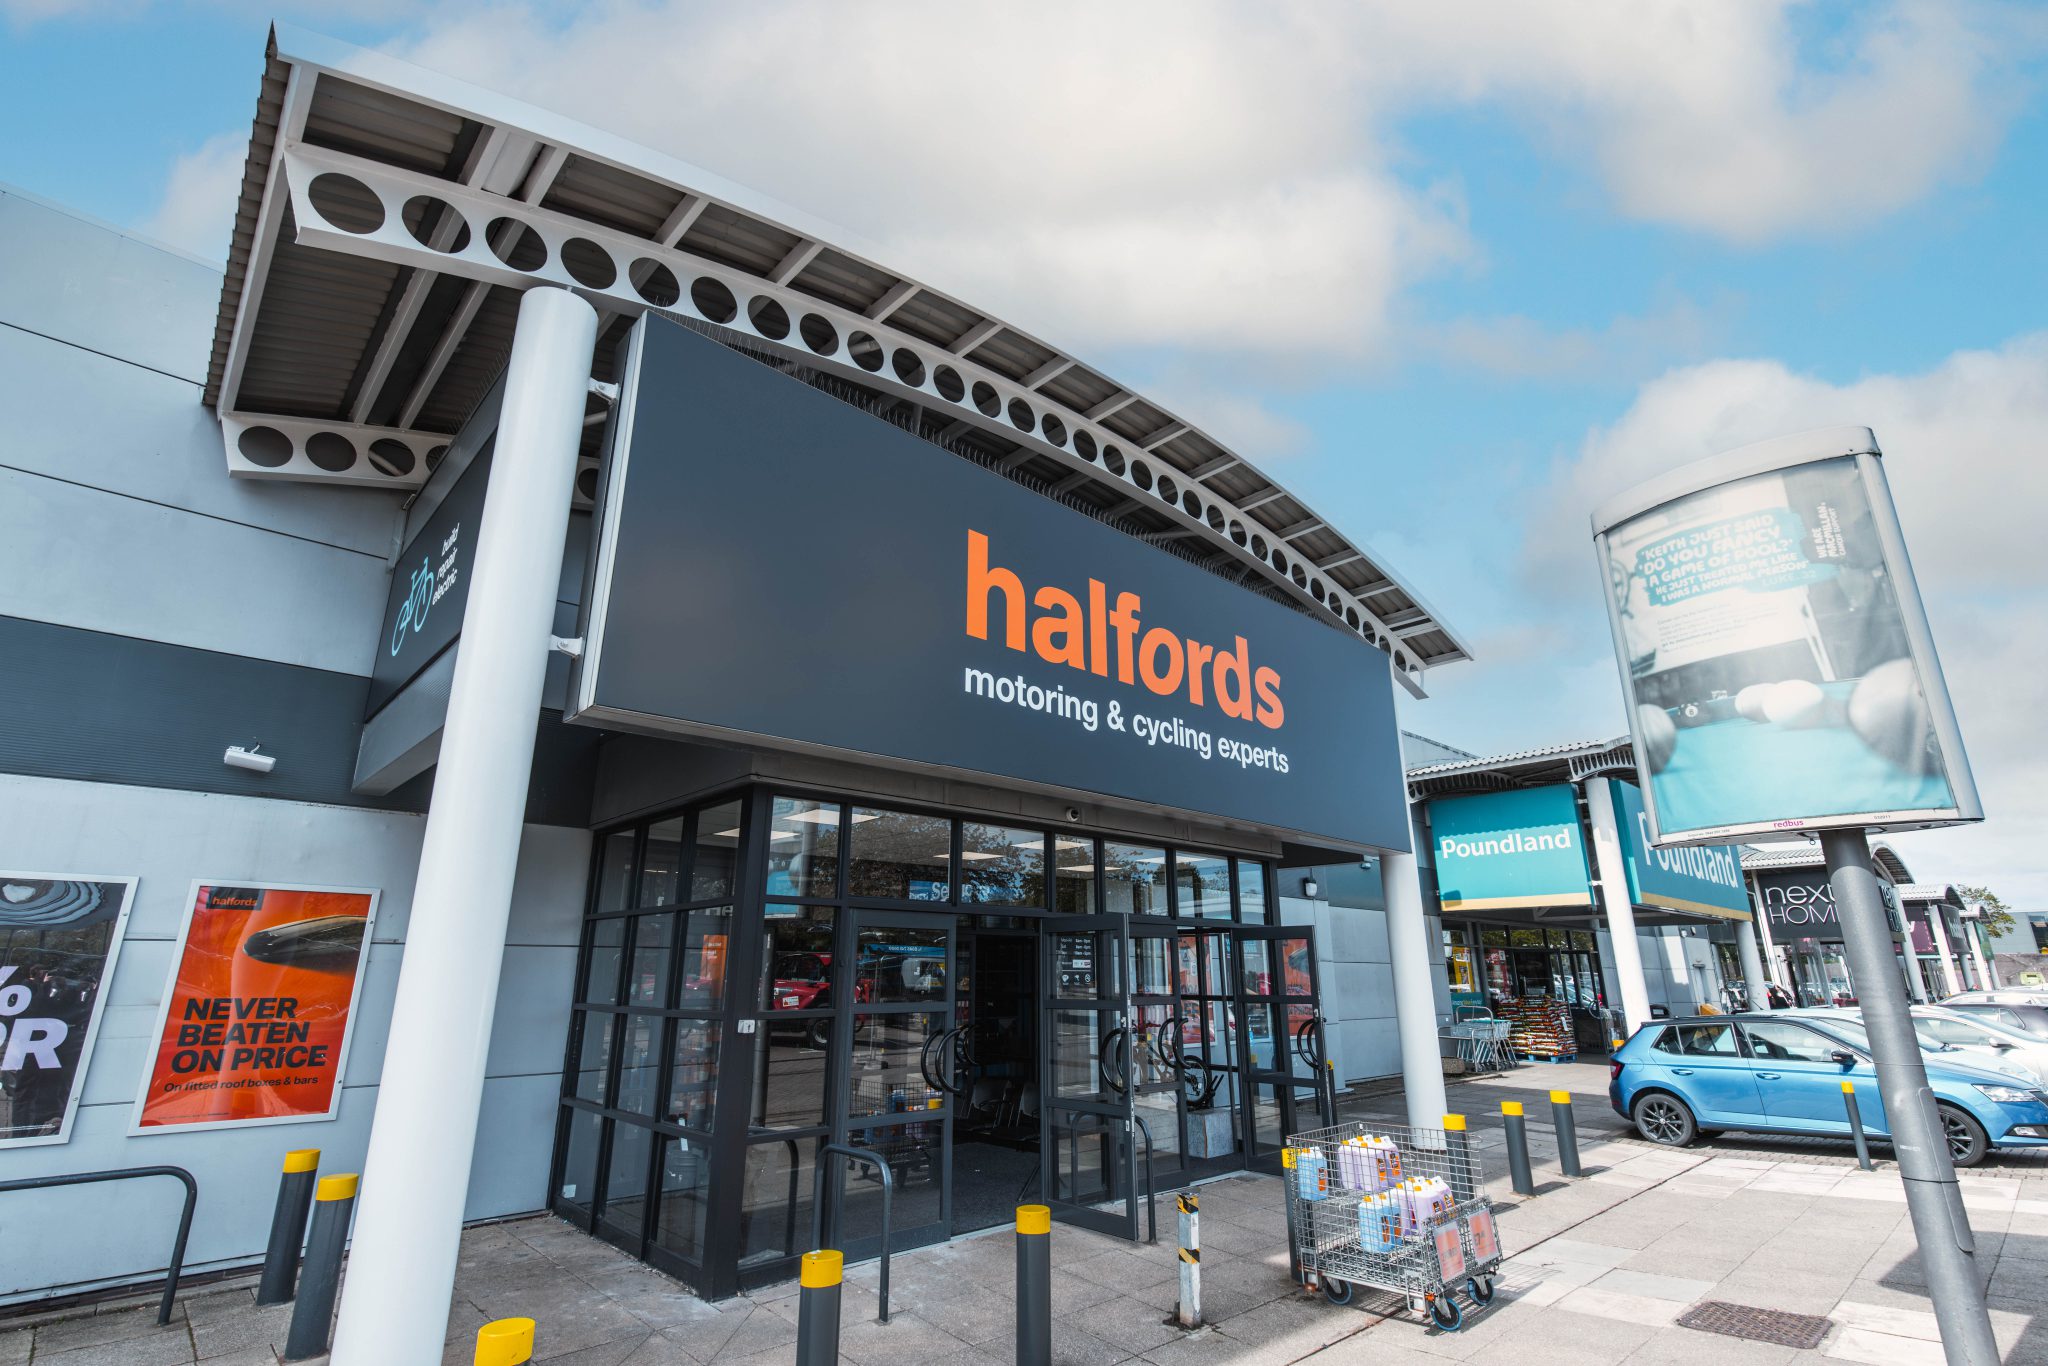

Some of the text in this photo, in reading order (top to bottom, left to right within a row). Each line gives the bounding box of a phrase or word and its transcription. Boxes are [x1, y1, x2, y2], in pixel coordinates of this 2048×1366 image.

[1690, 524, 1730, 545] JUST
[1733, 514, 1774, 532] SAID
[1668, 546, 1707, 566] YOU
[1712, 525, 1781, 554] FANCY
[432, 567, 458, 605] electric
[1650, 575, 1660, 588] A
[1661, 562, 1706, 584] GAME
[1708, 554, 1730, 568] OF
[1669, 576, 1695, 592] JUST
[1699, 564, 1747, 582] TREATED
[1750, 560, 1769, 570] ME
[1771, 552, 1799, 565] LIKE
[1667, 589, 1691, 601] WAS
[1691, 585, 1700, 594] A
[1702, 574, 1755, 591] NORMAL
[966, 528, 1285, 730] halfords
[964, 667, 1289, 774] motoring & cycling experts
[1773, 820, 1804, 828] redbus
[1441, 828, 1572, 859] Poundland
[212, 896, 258, 906] halfords
[1768, 904, 1841, 925] HOM
[184, 997, 299, 1021] NEVER
[177, 1021, 310, 1047] BEATEN
[171, 1045, 329, 1074] ON PRICE
[164, 1076, 319, 1092] On fitted roof boxes & bars
